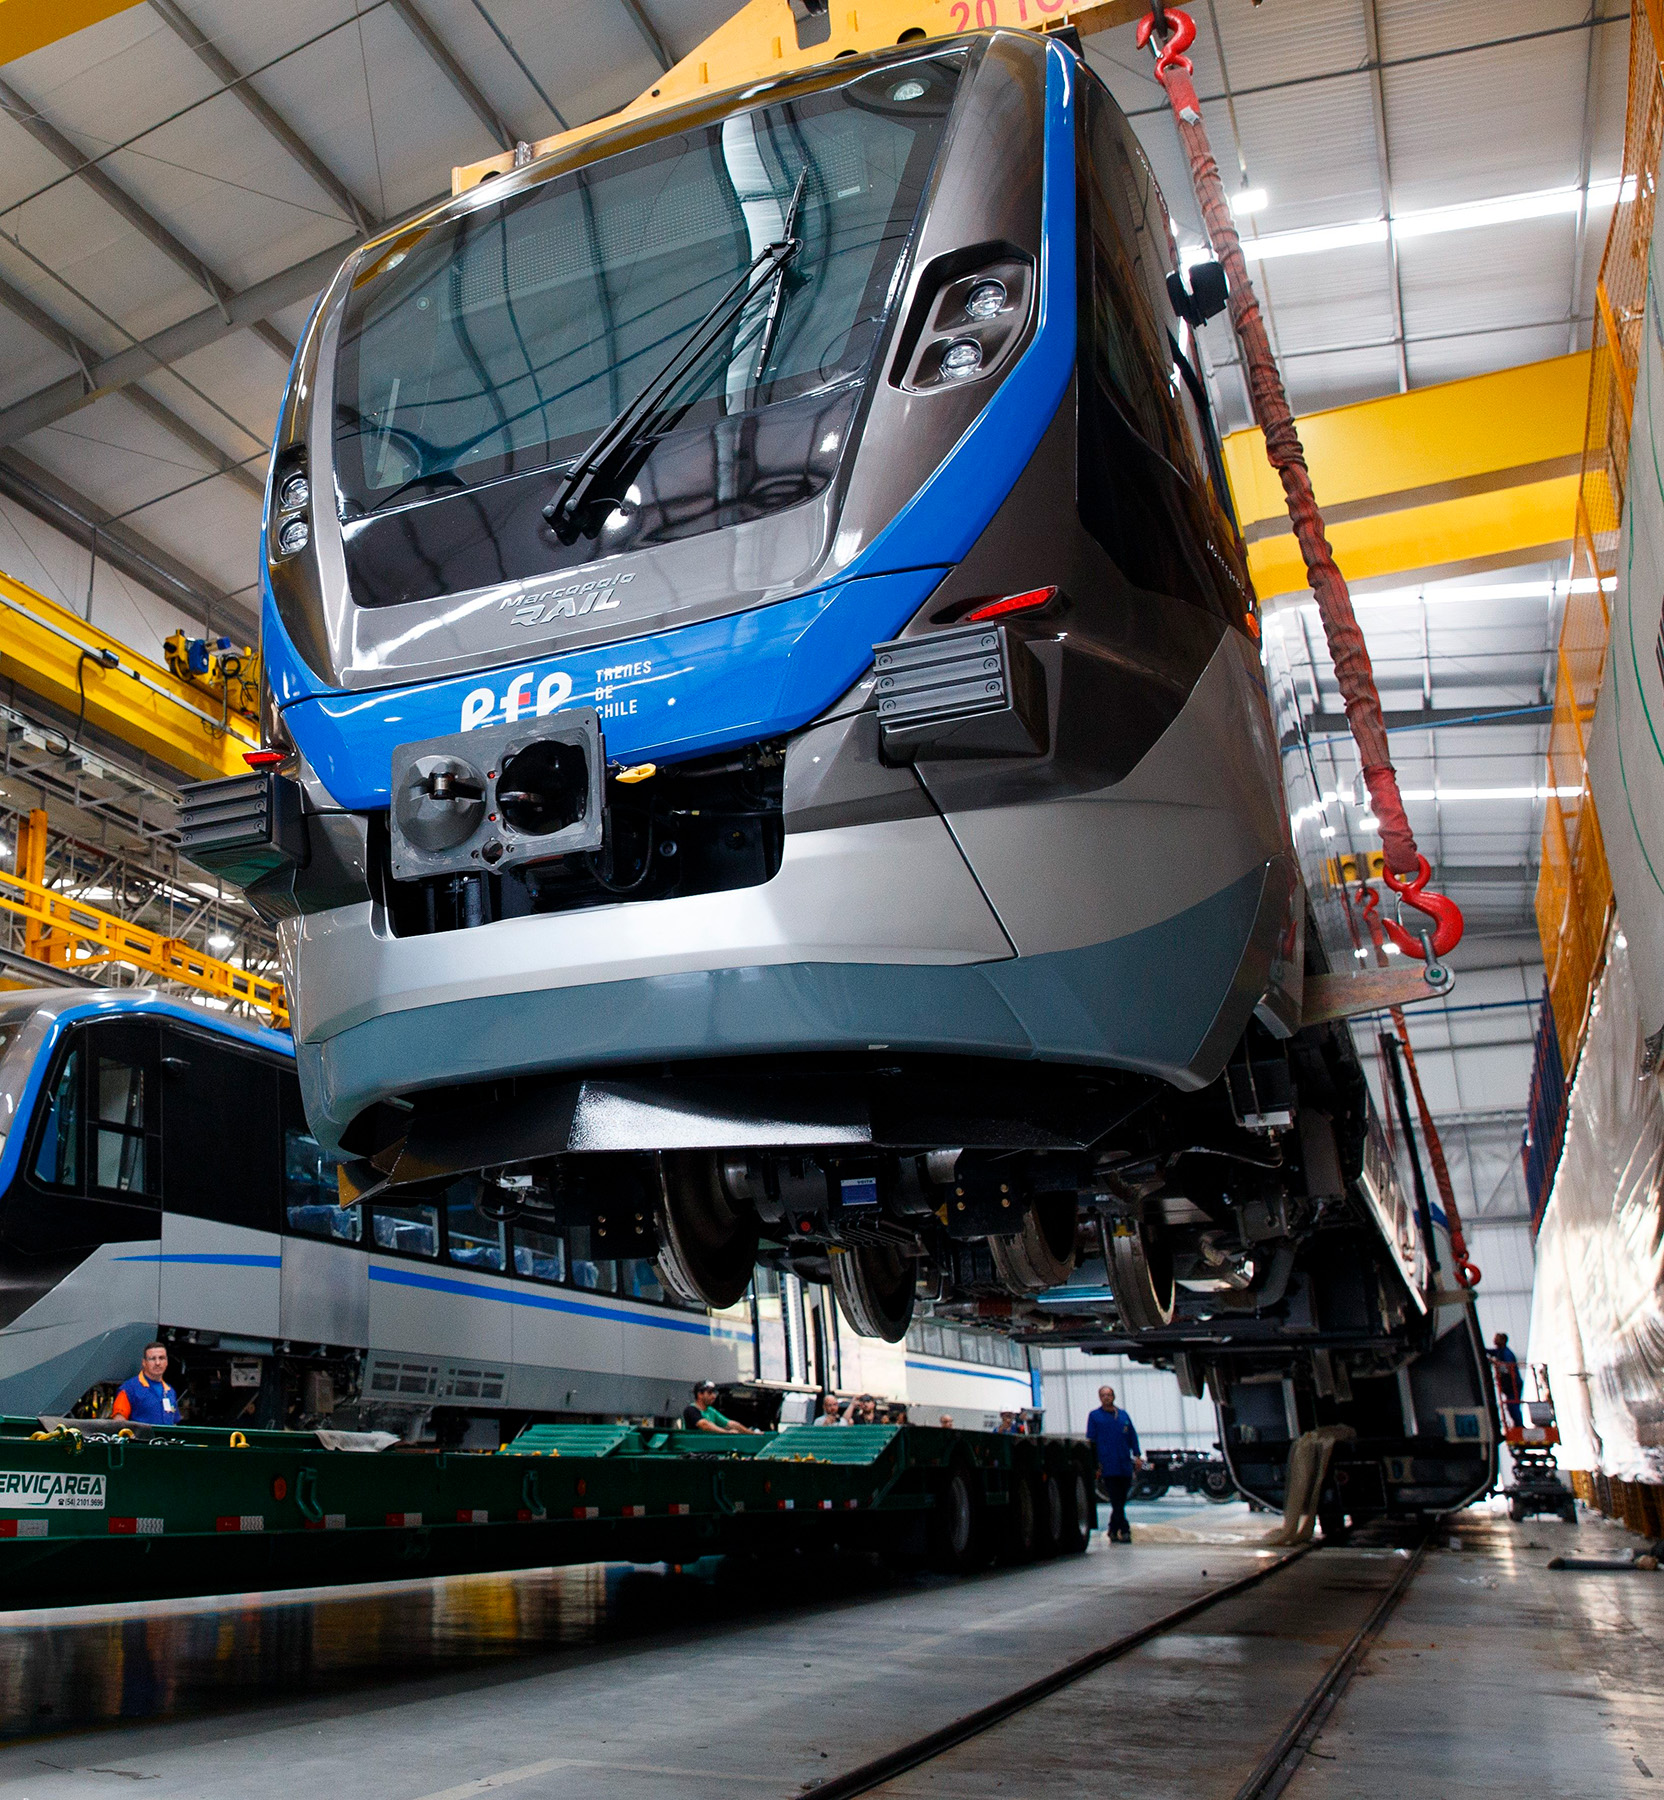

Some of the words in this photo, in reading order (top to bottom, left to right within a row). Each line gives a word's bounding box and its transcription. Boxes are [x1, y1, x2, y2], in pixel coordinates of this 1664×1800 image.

[498, 572, 636, 611] Marcopolo
[510, 588, 622, 627] RAIL
[595, 685, 613, 701] DE
[595, 699, 638, 719] CHILE
